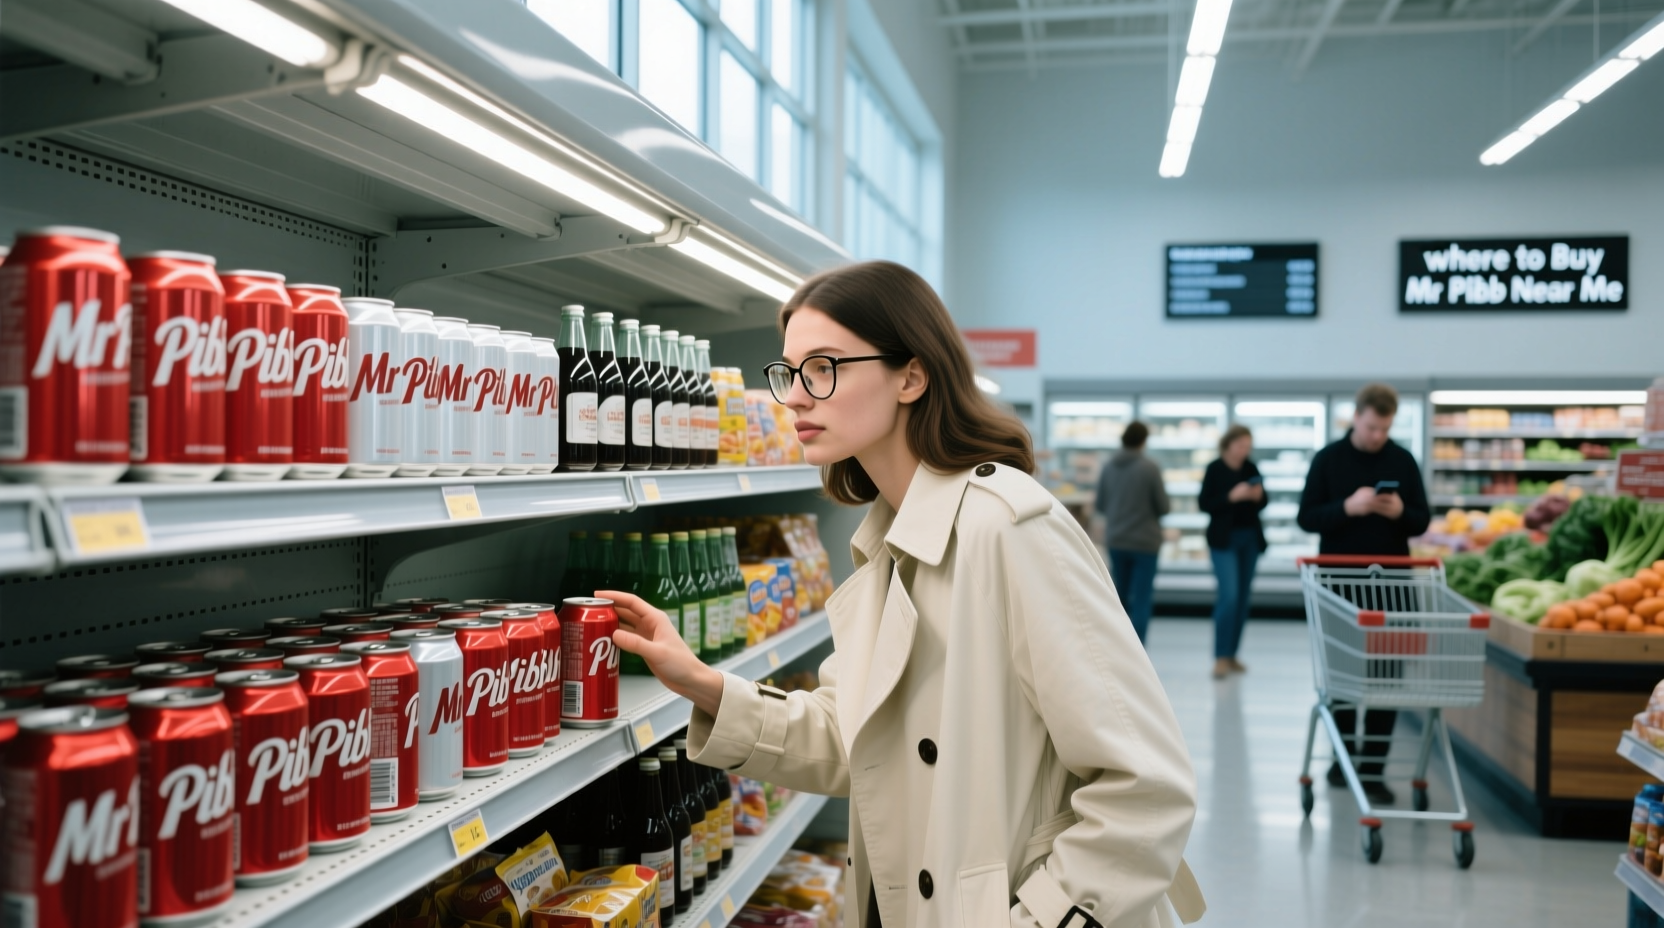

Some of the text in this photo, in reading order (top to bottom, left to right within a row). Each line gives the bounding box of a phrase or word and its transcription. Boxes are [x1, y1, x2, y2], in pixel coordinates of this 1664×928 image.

[1423, 242, 1605, 276] where to Buy
[1405, 275, 1444, 304] Mr
[1510, 274, 1576, 304] Near
[1579, 275, 1624, 303] Me
[292, 336, 349, 397] Pib
[349, 352, 401, 402] Mr
[438, 363, 472, 405] Mr
[506, 373, 537, 415] Mr
[158, 748, 236, 840] Pib
